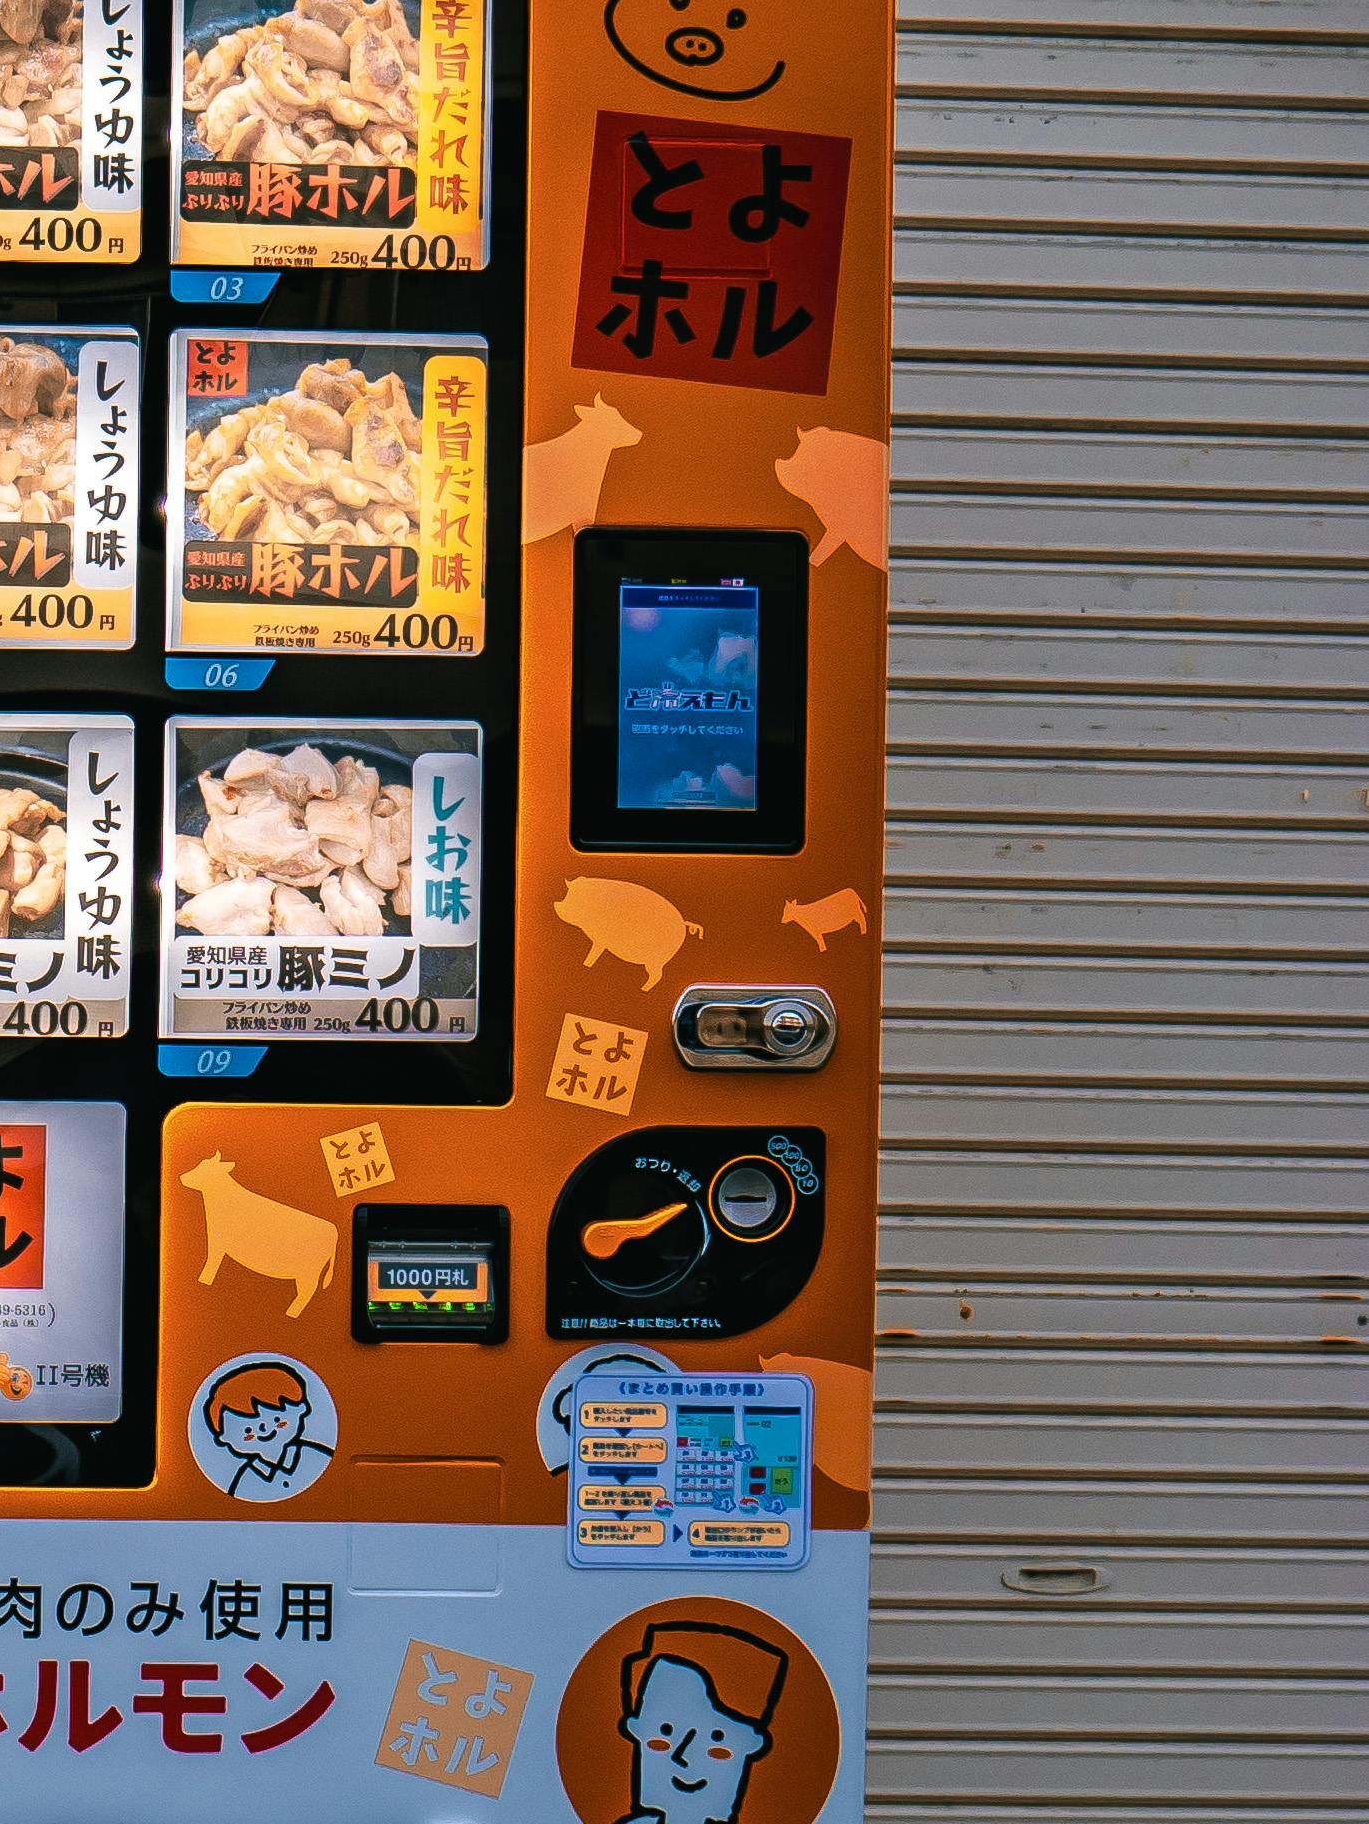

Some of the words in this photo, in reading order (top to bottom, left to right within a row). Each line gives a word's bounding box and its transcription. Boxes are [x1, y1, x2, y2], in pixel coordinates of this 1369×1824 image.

[247, 163, 417, 219] 豚ホル
[626, 131, 813, 243] とよ
[331, 250, 368, 268] 250g
[211, 277, 243, 300] 03
[595, 259, 814, 360] ホル
[86, 360, 127, 570] しょうゆ味
[204, 663, 239, 687] 06
[186, 946, 267, 966] 愛知県産
[277, 946, 416, 992] 豚ミノ
[181, 968, 272, 989] コリコリ
[571, 1022, 635, 1064] とよ
[197, 1050, 231, 1073] 09
[555, 1063, 627, 1102] ホル
[387, 1269, 469, 1287] 1000円札
